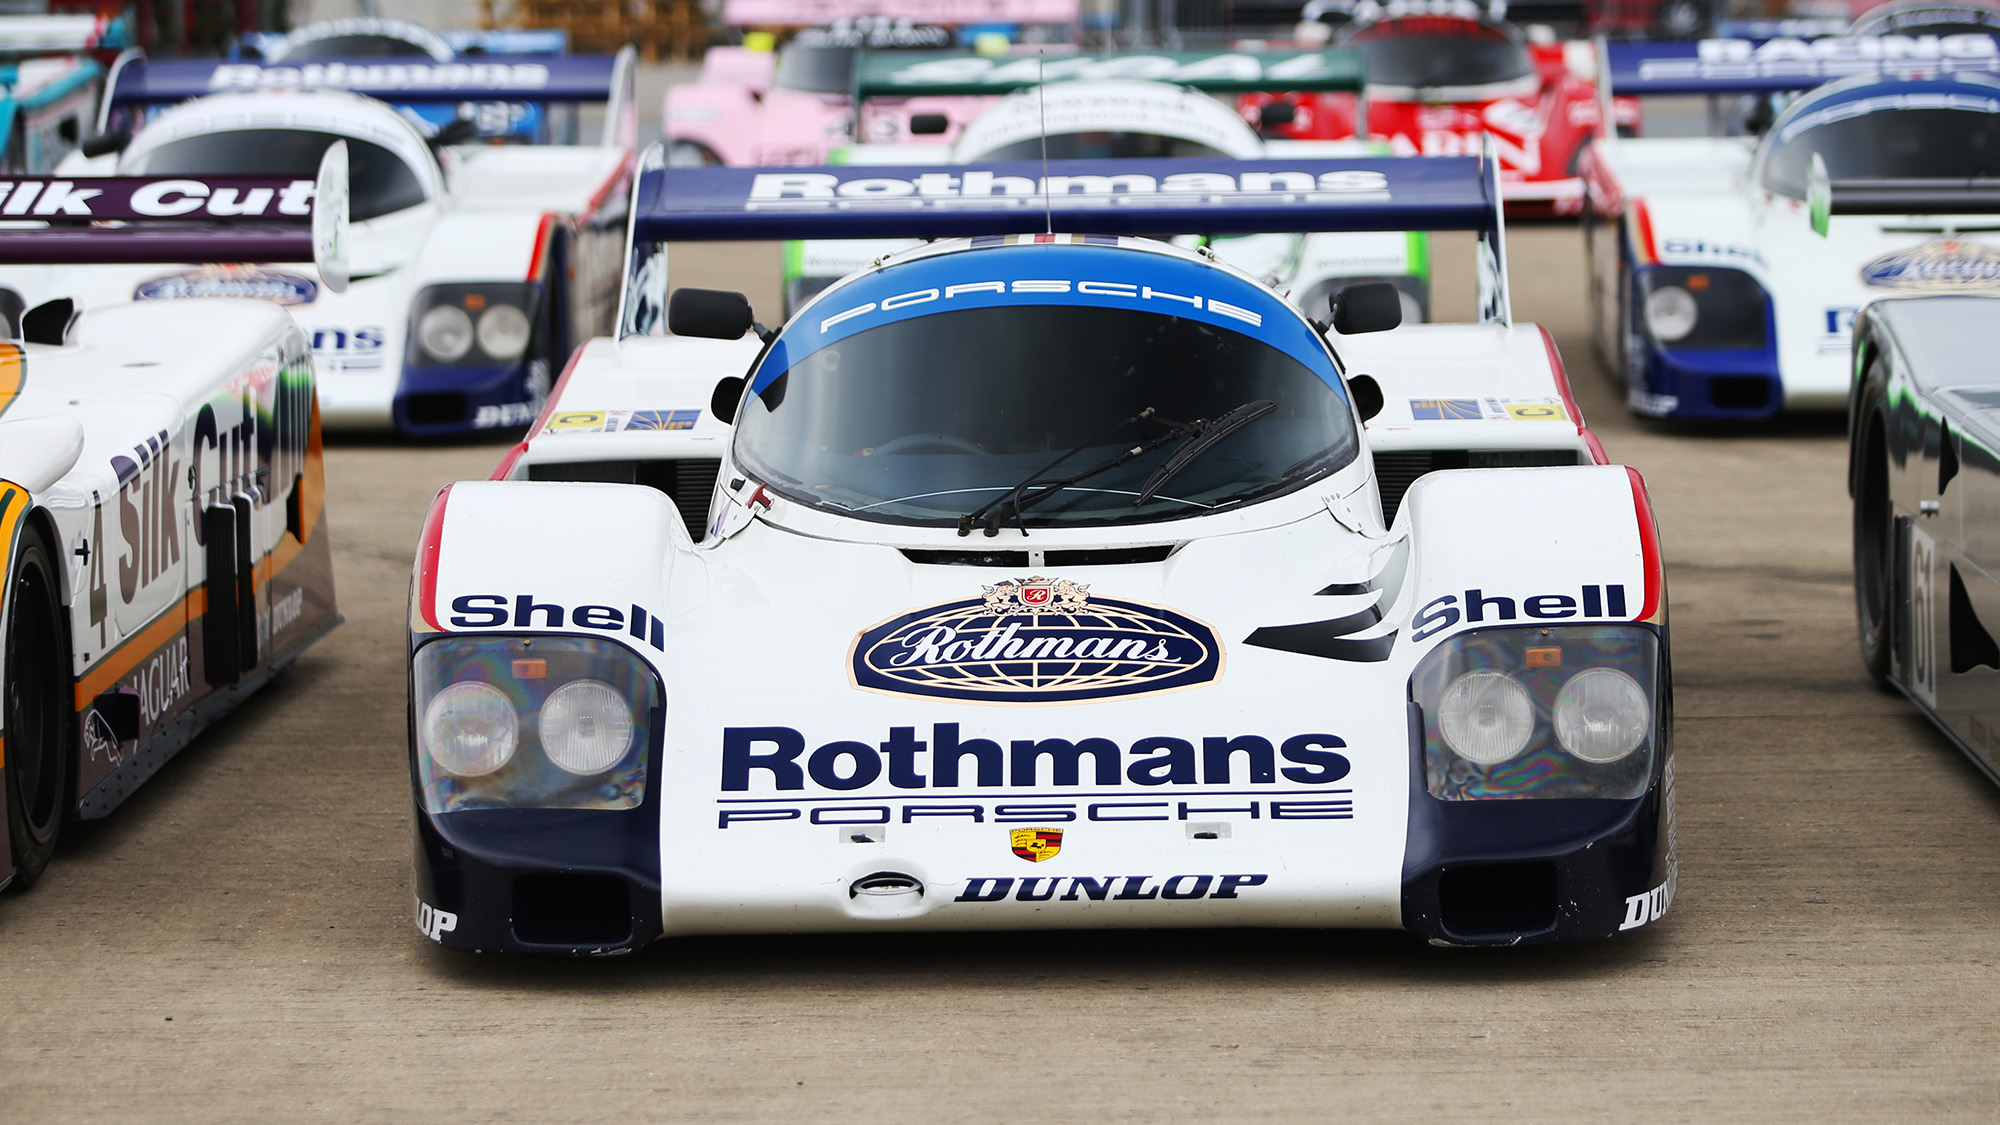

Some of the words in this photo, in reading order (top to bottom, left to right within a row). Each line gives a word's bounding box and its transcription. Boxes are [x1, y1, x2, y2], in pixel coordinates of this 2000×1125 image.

[130, 180, 317, 216] Cut
[749, 170, 1389, 200] Rothmans
[820, 280, 1262, 333] PORSCHE
[110, 428, 182, 605] Silk
[449, 594, 666, 652] Shell
[1411, 584, 1626, 643] Shell
[889, 622, 1181, 666] Rothmans
[720, 722, 1352, 791] Rothmans
[719, 800, 1354, 829] PORSCHE
[954, 873, 1269, 902] DUNLOP
